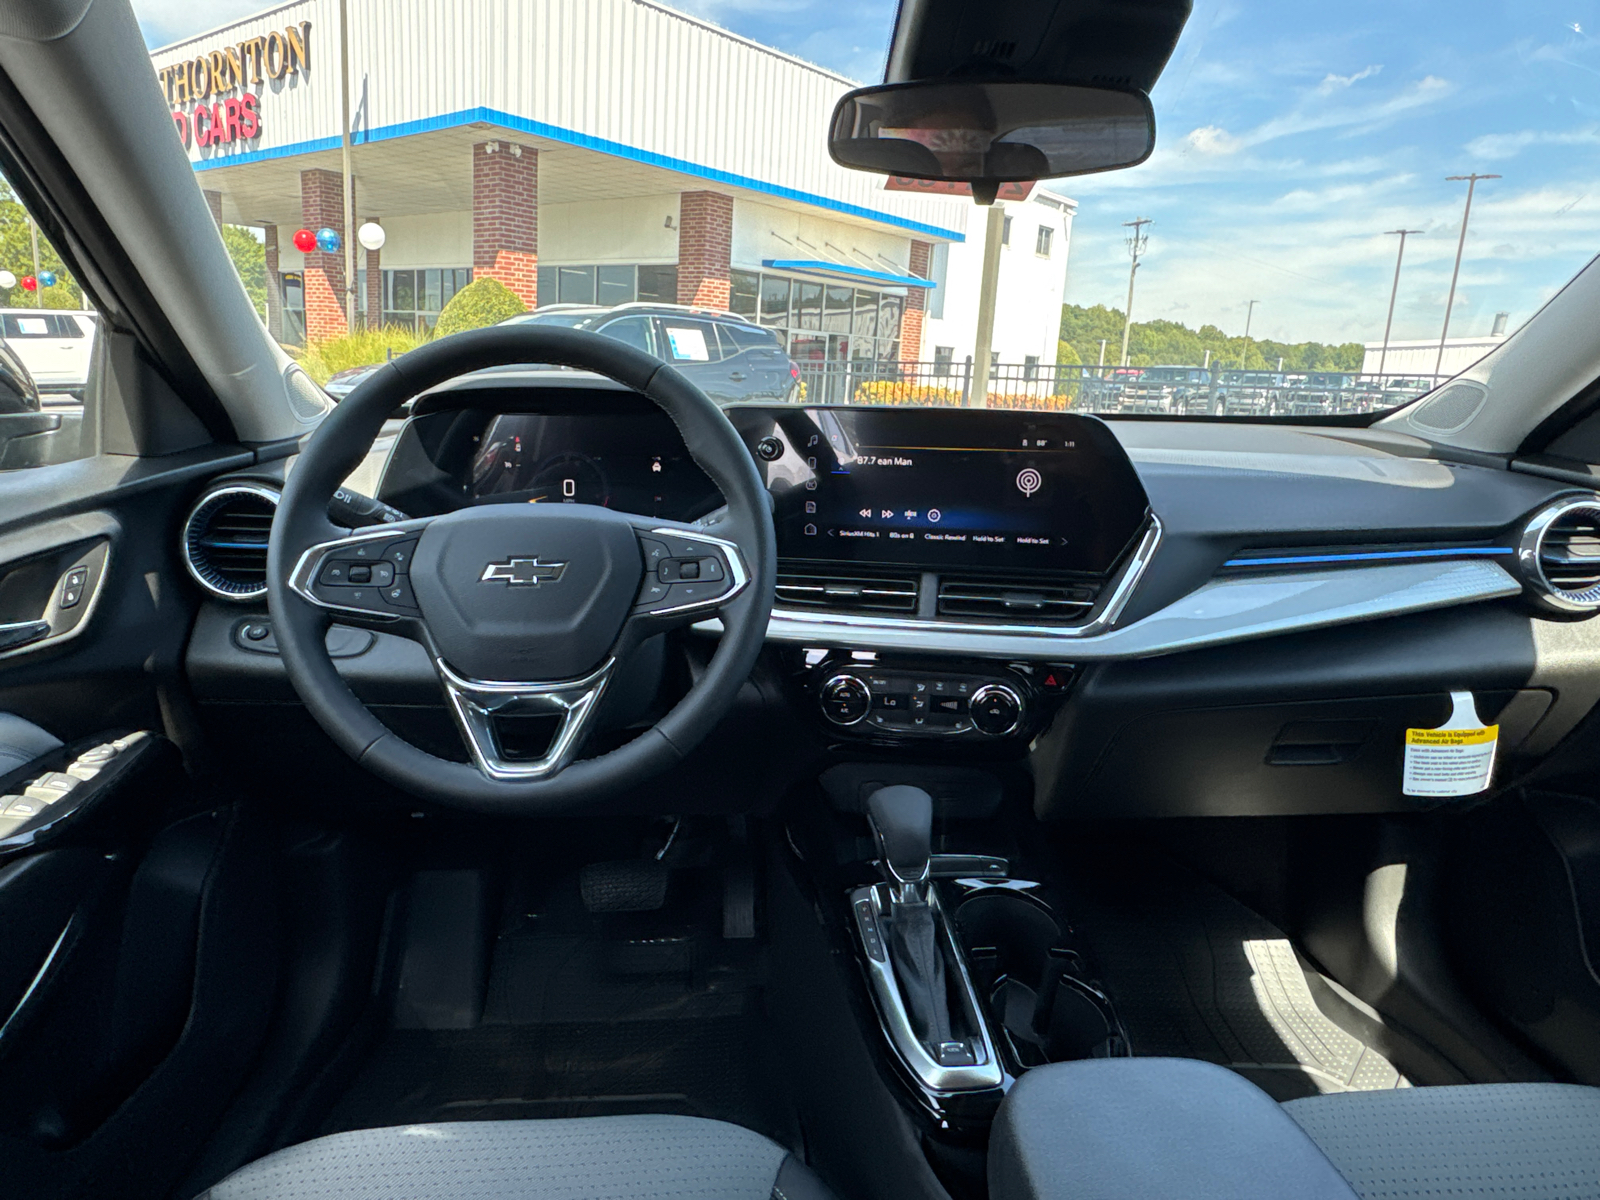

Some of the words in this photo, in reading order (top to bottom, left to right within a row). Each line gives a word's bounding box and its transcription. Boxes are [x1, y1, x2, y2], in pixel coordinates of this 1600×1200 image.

[158, 21, 311, 105] THORNTON
[194, 93, 258, 147] CARS
[857, 456, 876, 465] 87.7
[894, 457, 913, 466] Man
[563, 479, 575, 497] 0
